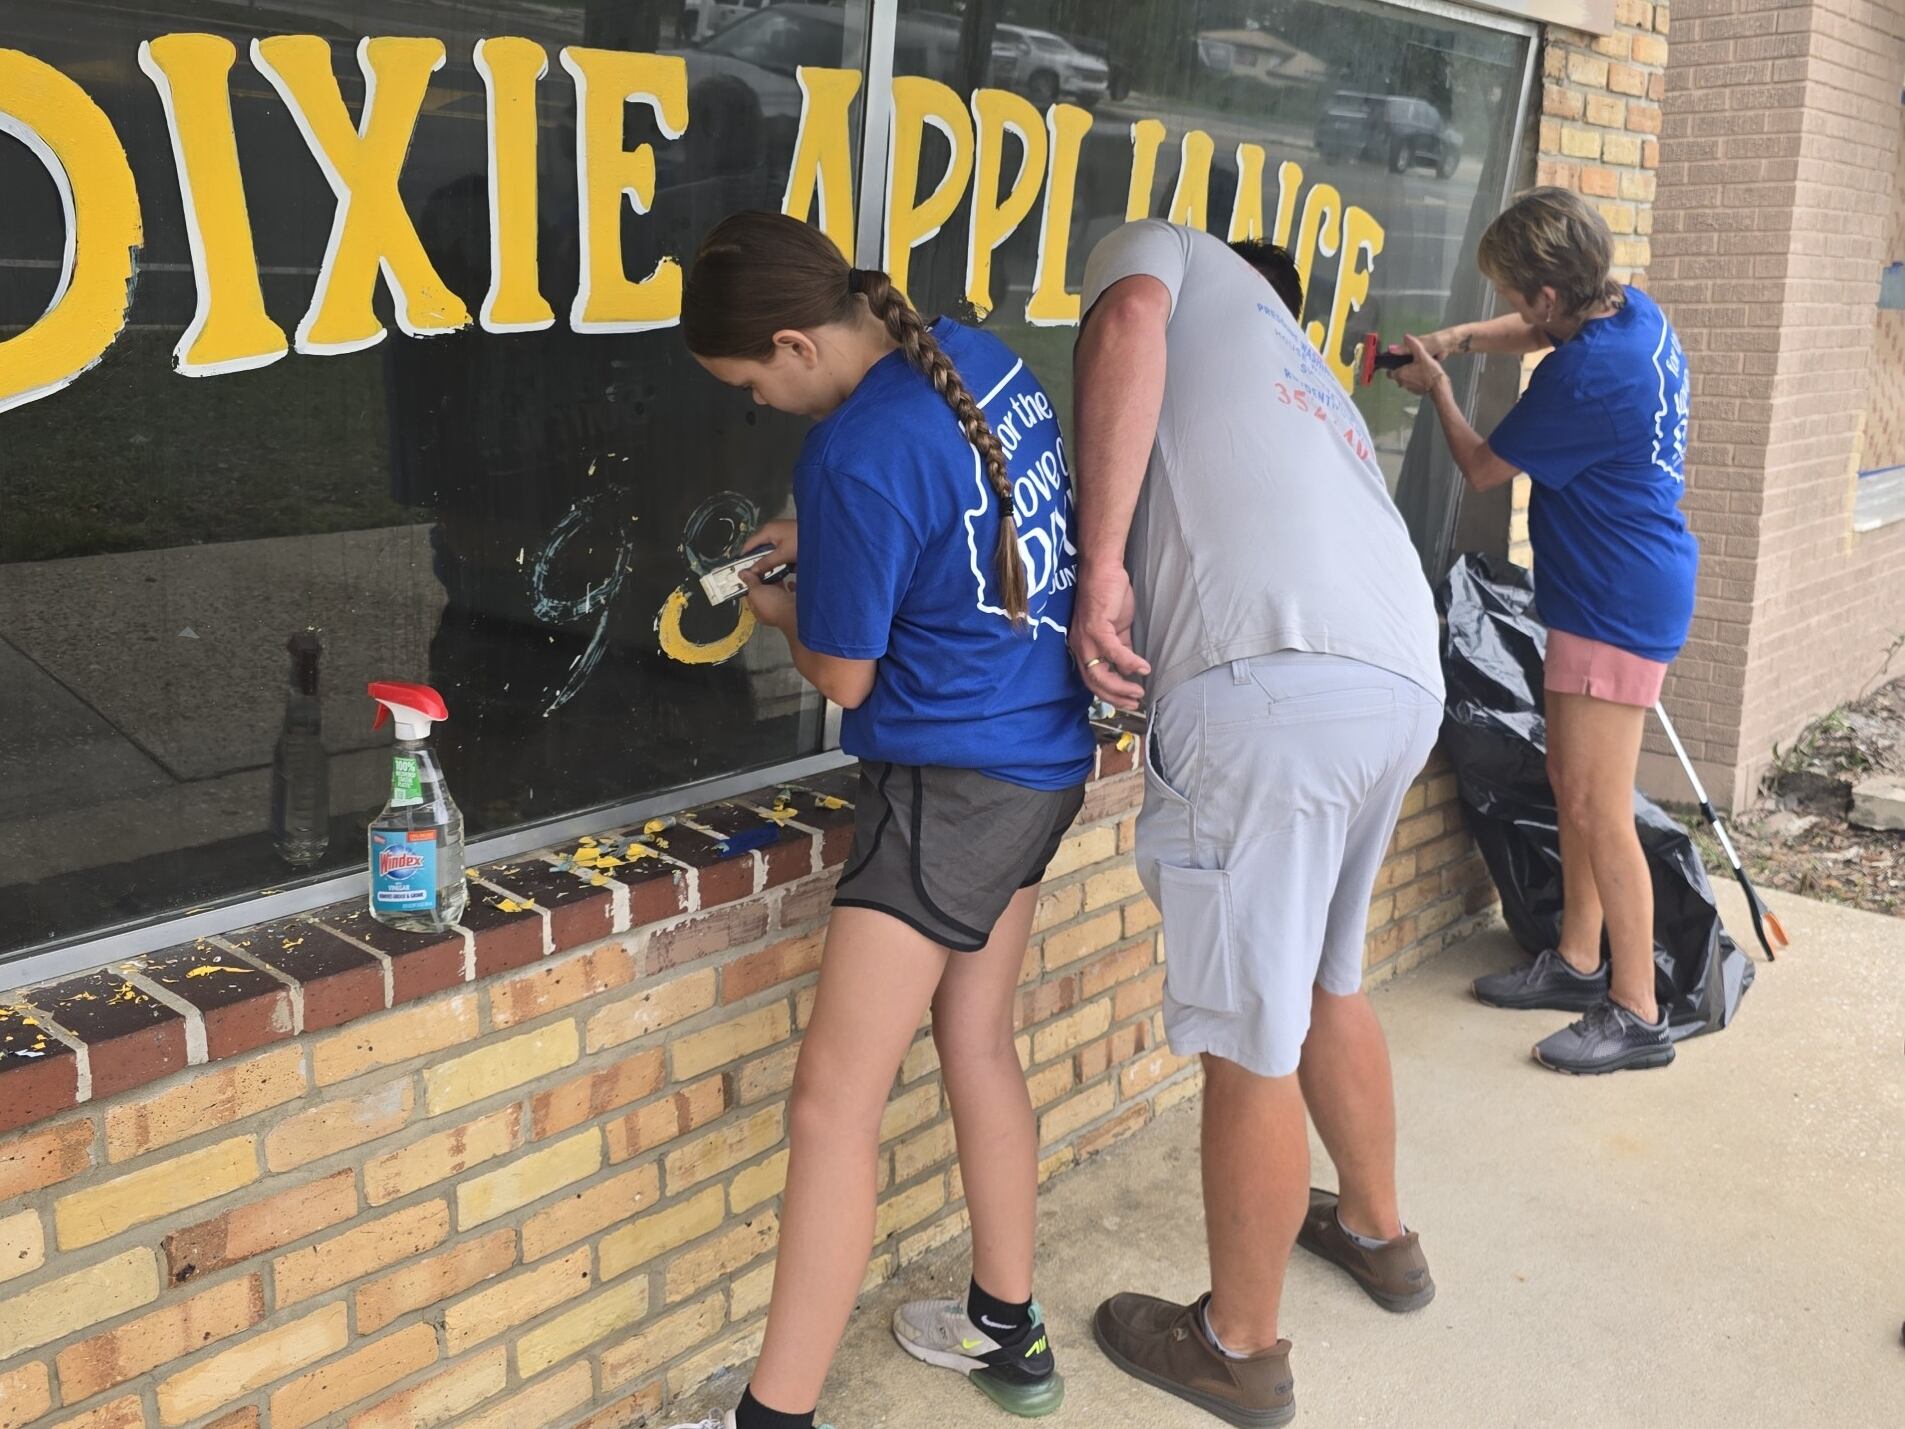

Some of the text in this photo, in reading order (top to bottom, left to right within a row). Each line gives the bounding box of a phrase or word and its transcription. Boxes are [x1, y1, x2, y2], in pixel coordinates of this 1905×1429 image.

[997, 391, 1053, 460] or the
[379, 850, 423, 876] Windex
